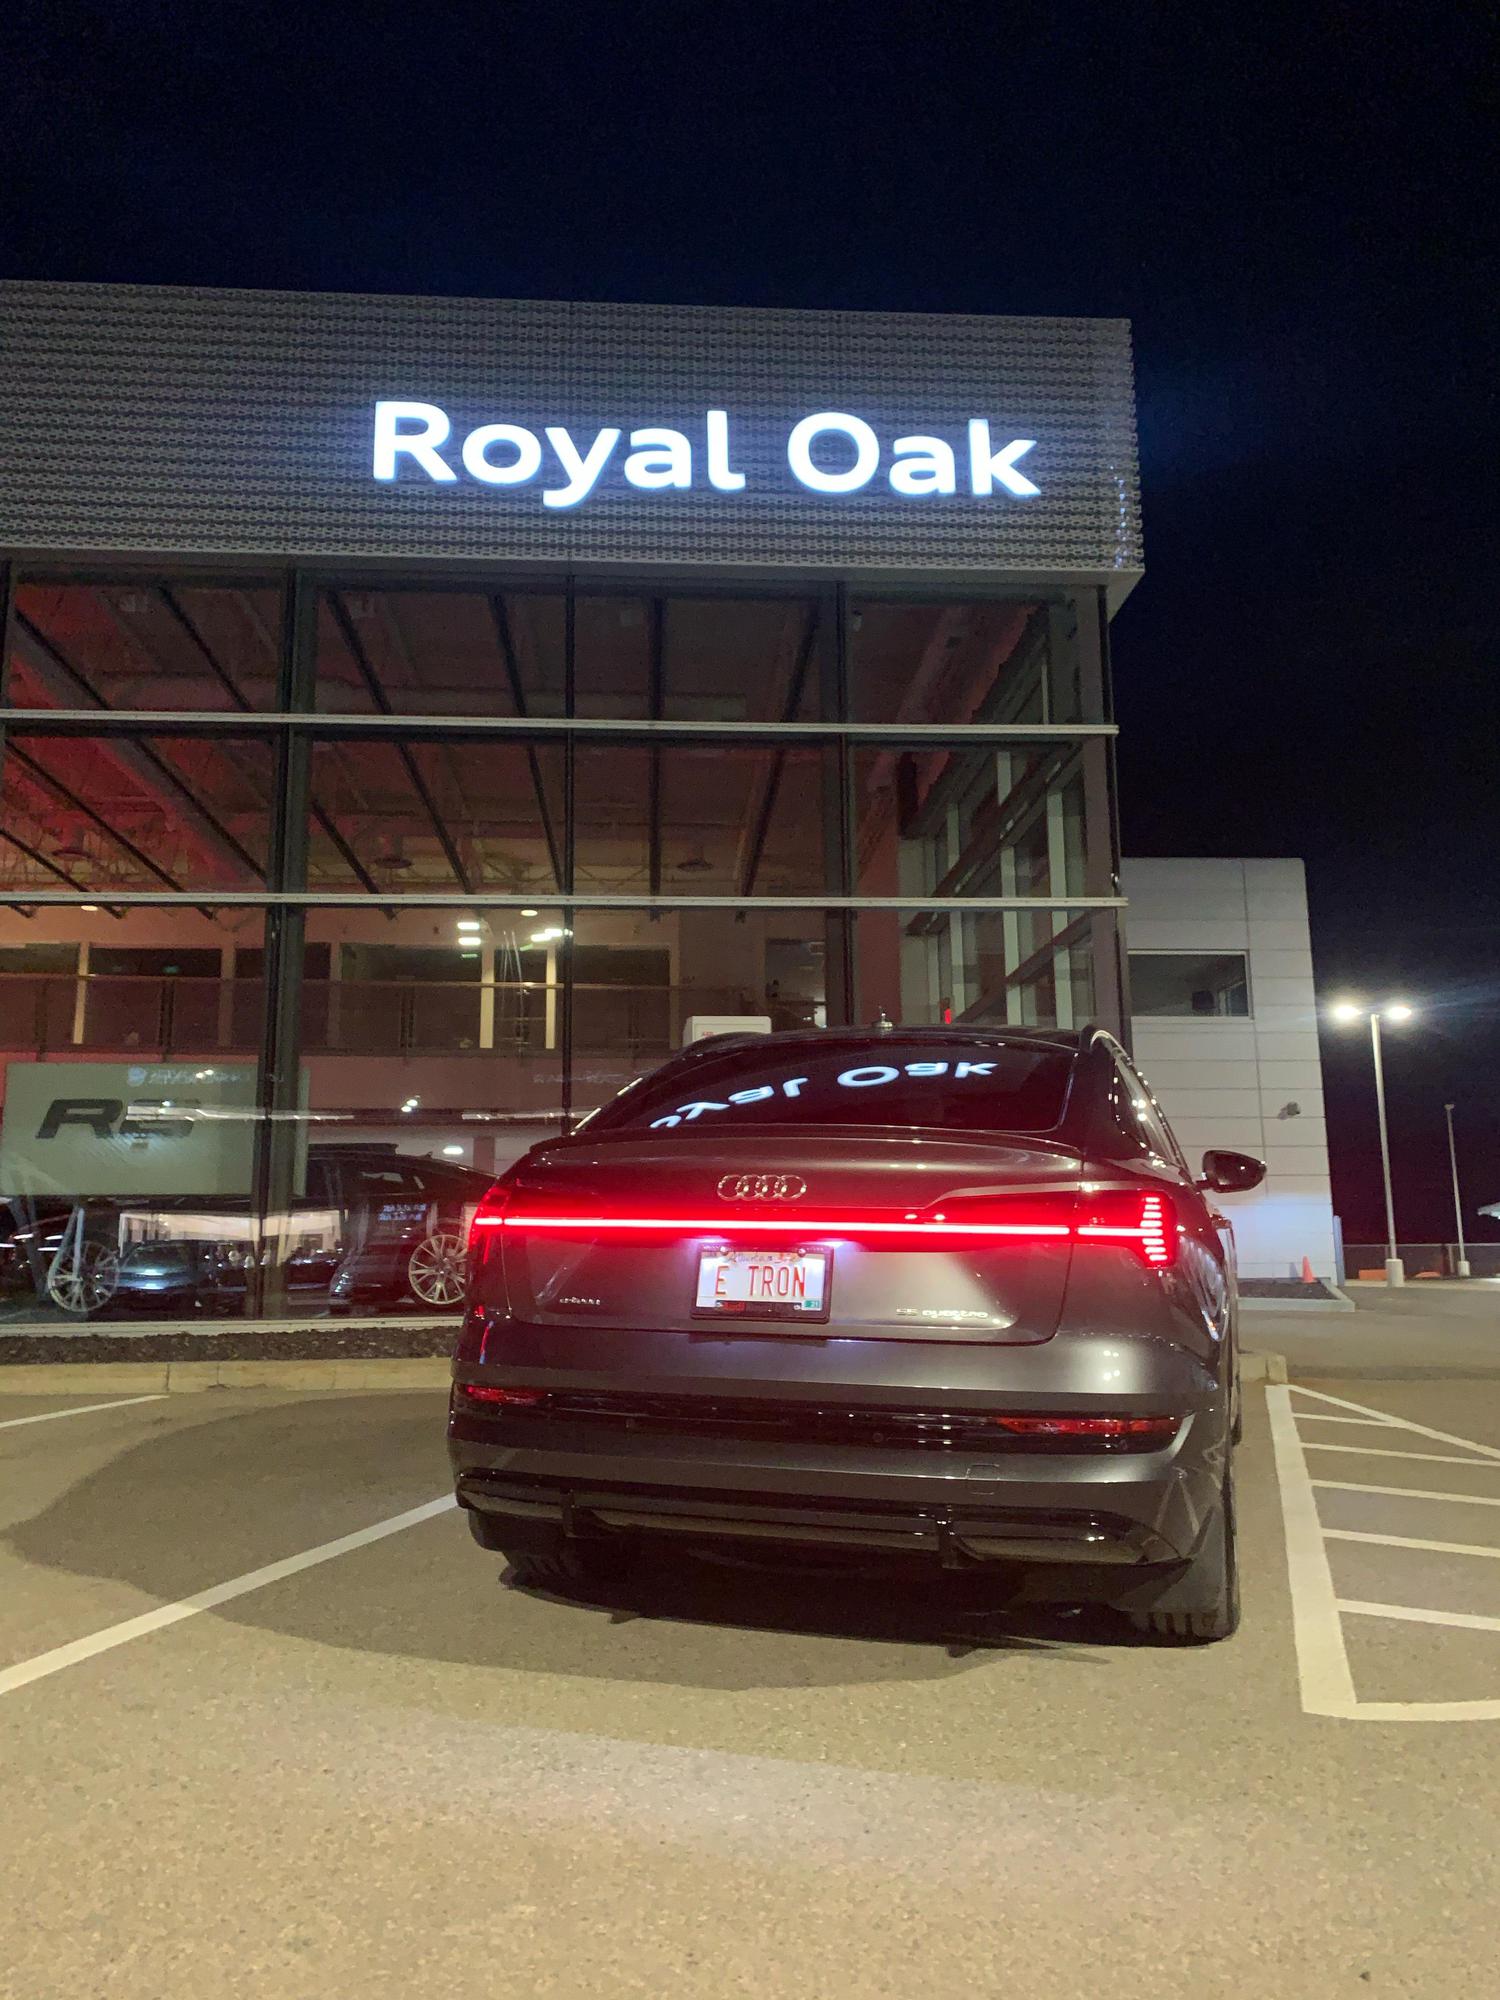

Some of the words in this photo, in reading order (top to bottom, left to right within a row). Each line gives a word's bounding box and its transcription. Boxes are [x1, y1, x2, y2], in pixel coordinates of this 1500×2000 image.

[372, 400, 747, 510] Royal
[786, 411, 1042, 496] Oak
[715, 1265, 729, 1296] E
[748, 1265, 807, 1298] TRON
